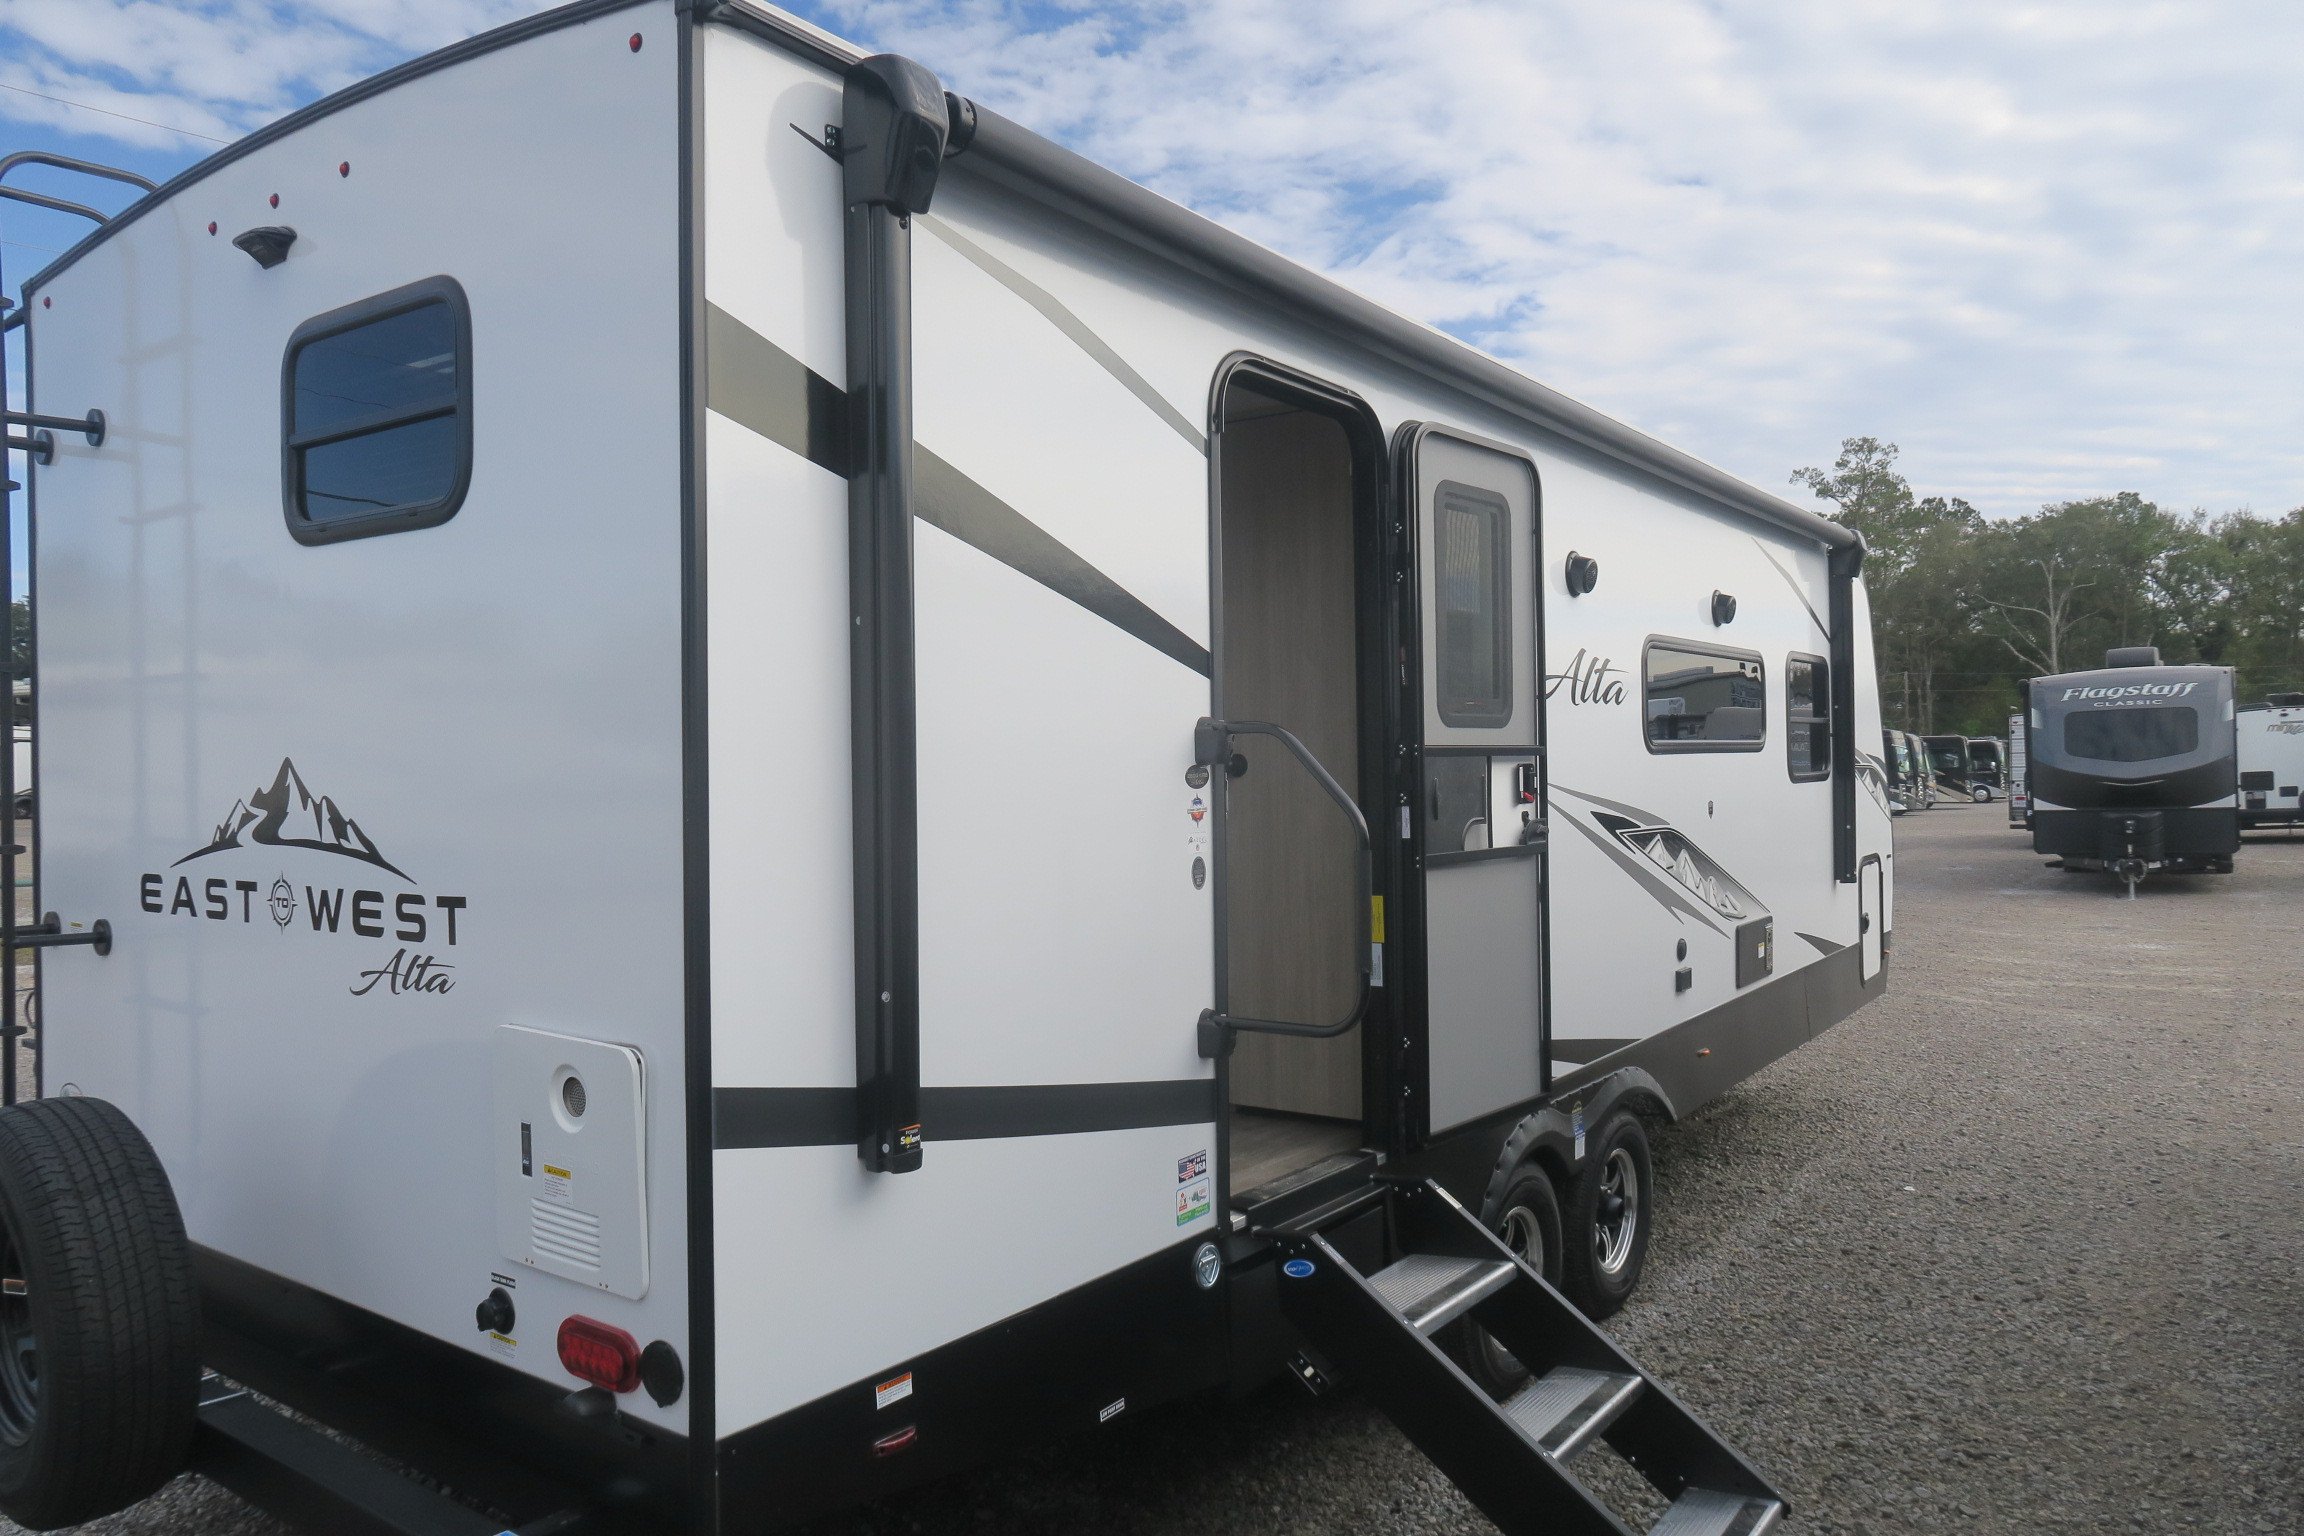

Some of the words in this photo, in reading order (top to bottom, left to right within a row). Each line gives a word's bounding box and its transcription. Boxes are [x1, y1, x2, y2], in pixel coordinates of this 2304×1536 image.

[1541, 647, 1629, 706] Alta
[2060, 682, 2198, 702] Flagstaff
[2093, 699, 2163, 708] CLASSIC
[140, 873, 258, 923] EAST
[275, 897, 289, 909] TO
[305, 885, 467, 946] WEST
[349, 948, 456, 996] Alta
